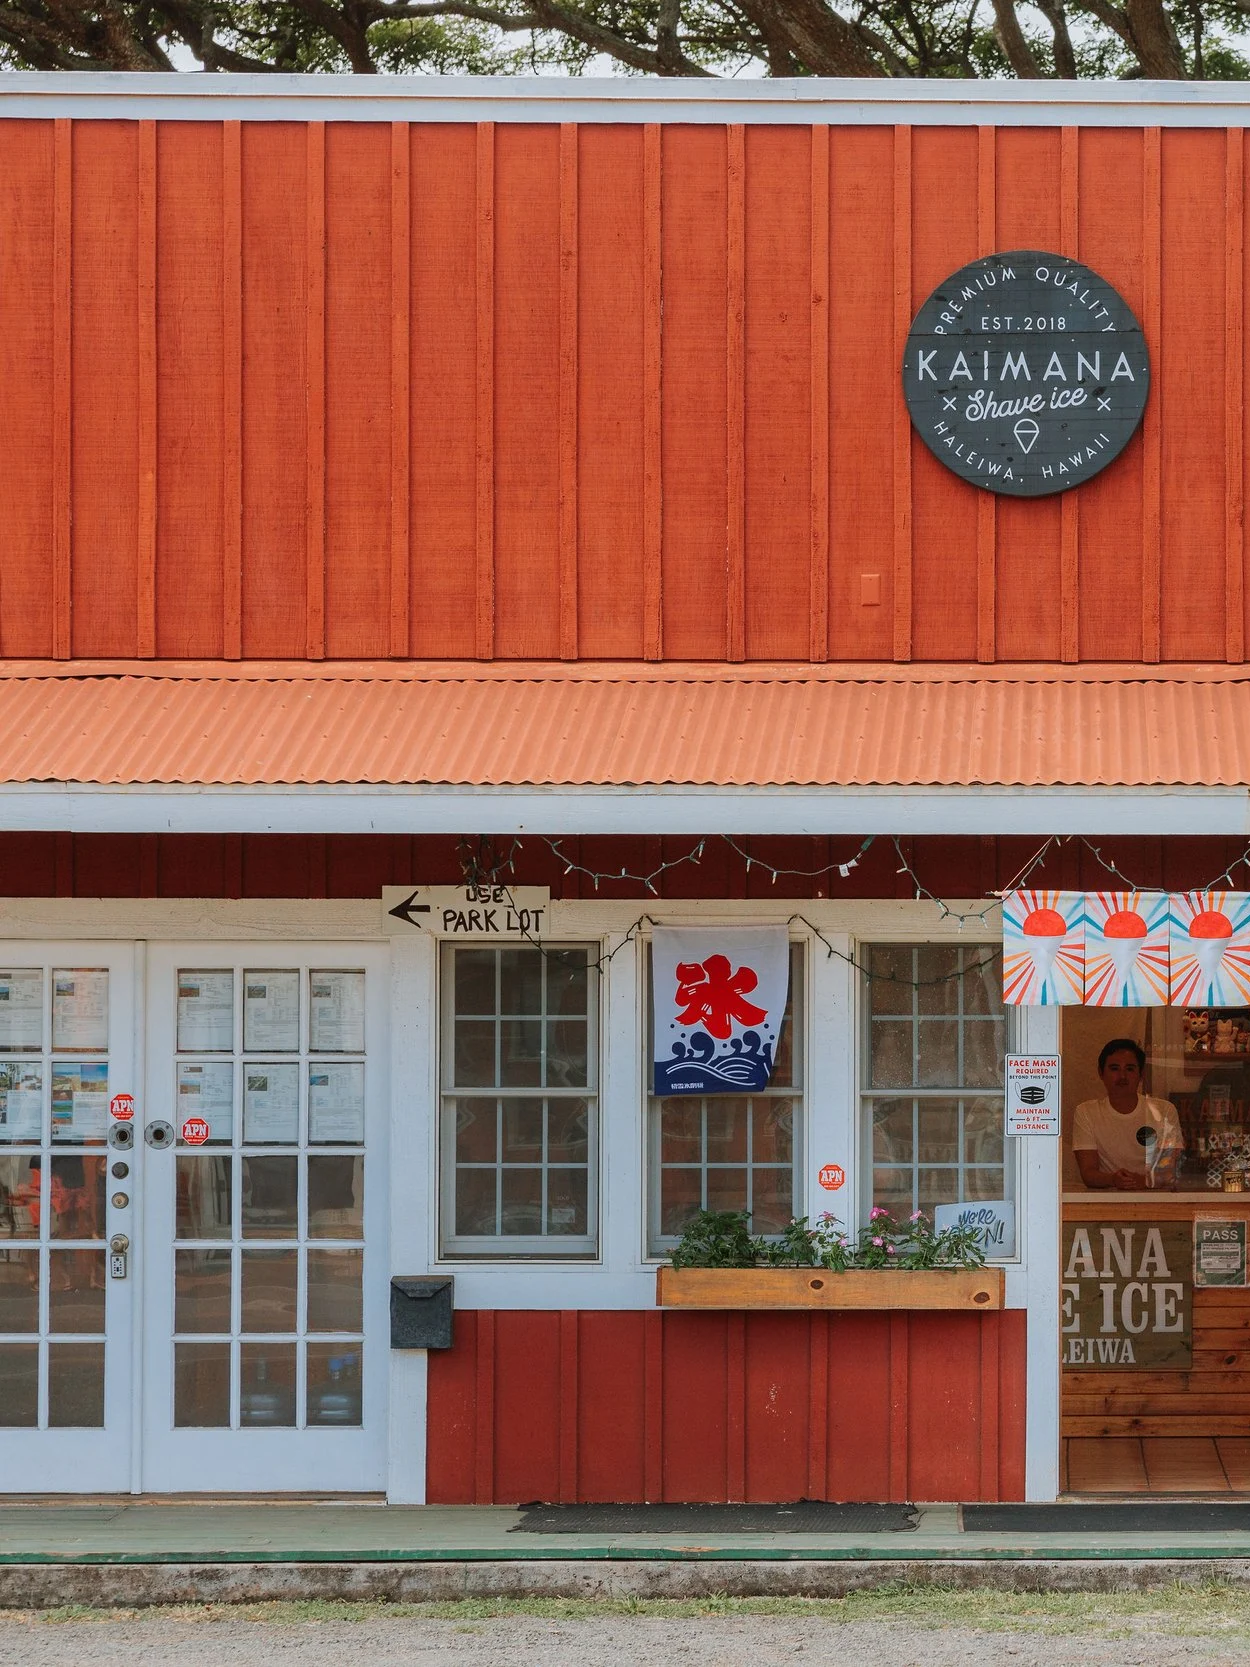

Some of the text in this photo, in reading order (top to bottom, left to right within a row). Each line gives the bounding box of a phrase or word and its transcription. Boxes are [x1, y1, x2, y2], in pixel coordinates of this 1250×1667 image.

[934, 266, 1116, 335] PREMIUM QUALITY
[918, 350, 1135, 381] KAIMANA
[965, 386, 1088, 421] Shave ice
[1042, 433, 1110, 478] HAWAII
[466, 887, 504, 904] USE
[443, 909, 544, 932] PARK LOT
[674, 953, 769, 1040] 氷
[184, 1123, 207, 1136] APN
[820, 1170, 843, 1182] APN
[1203, 1230, 1238, 1240] PASS
[1064, 1227, 1171, 1278] ANA
[1100, 1281, 1184, 1334] ICE
